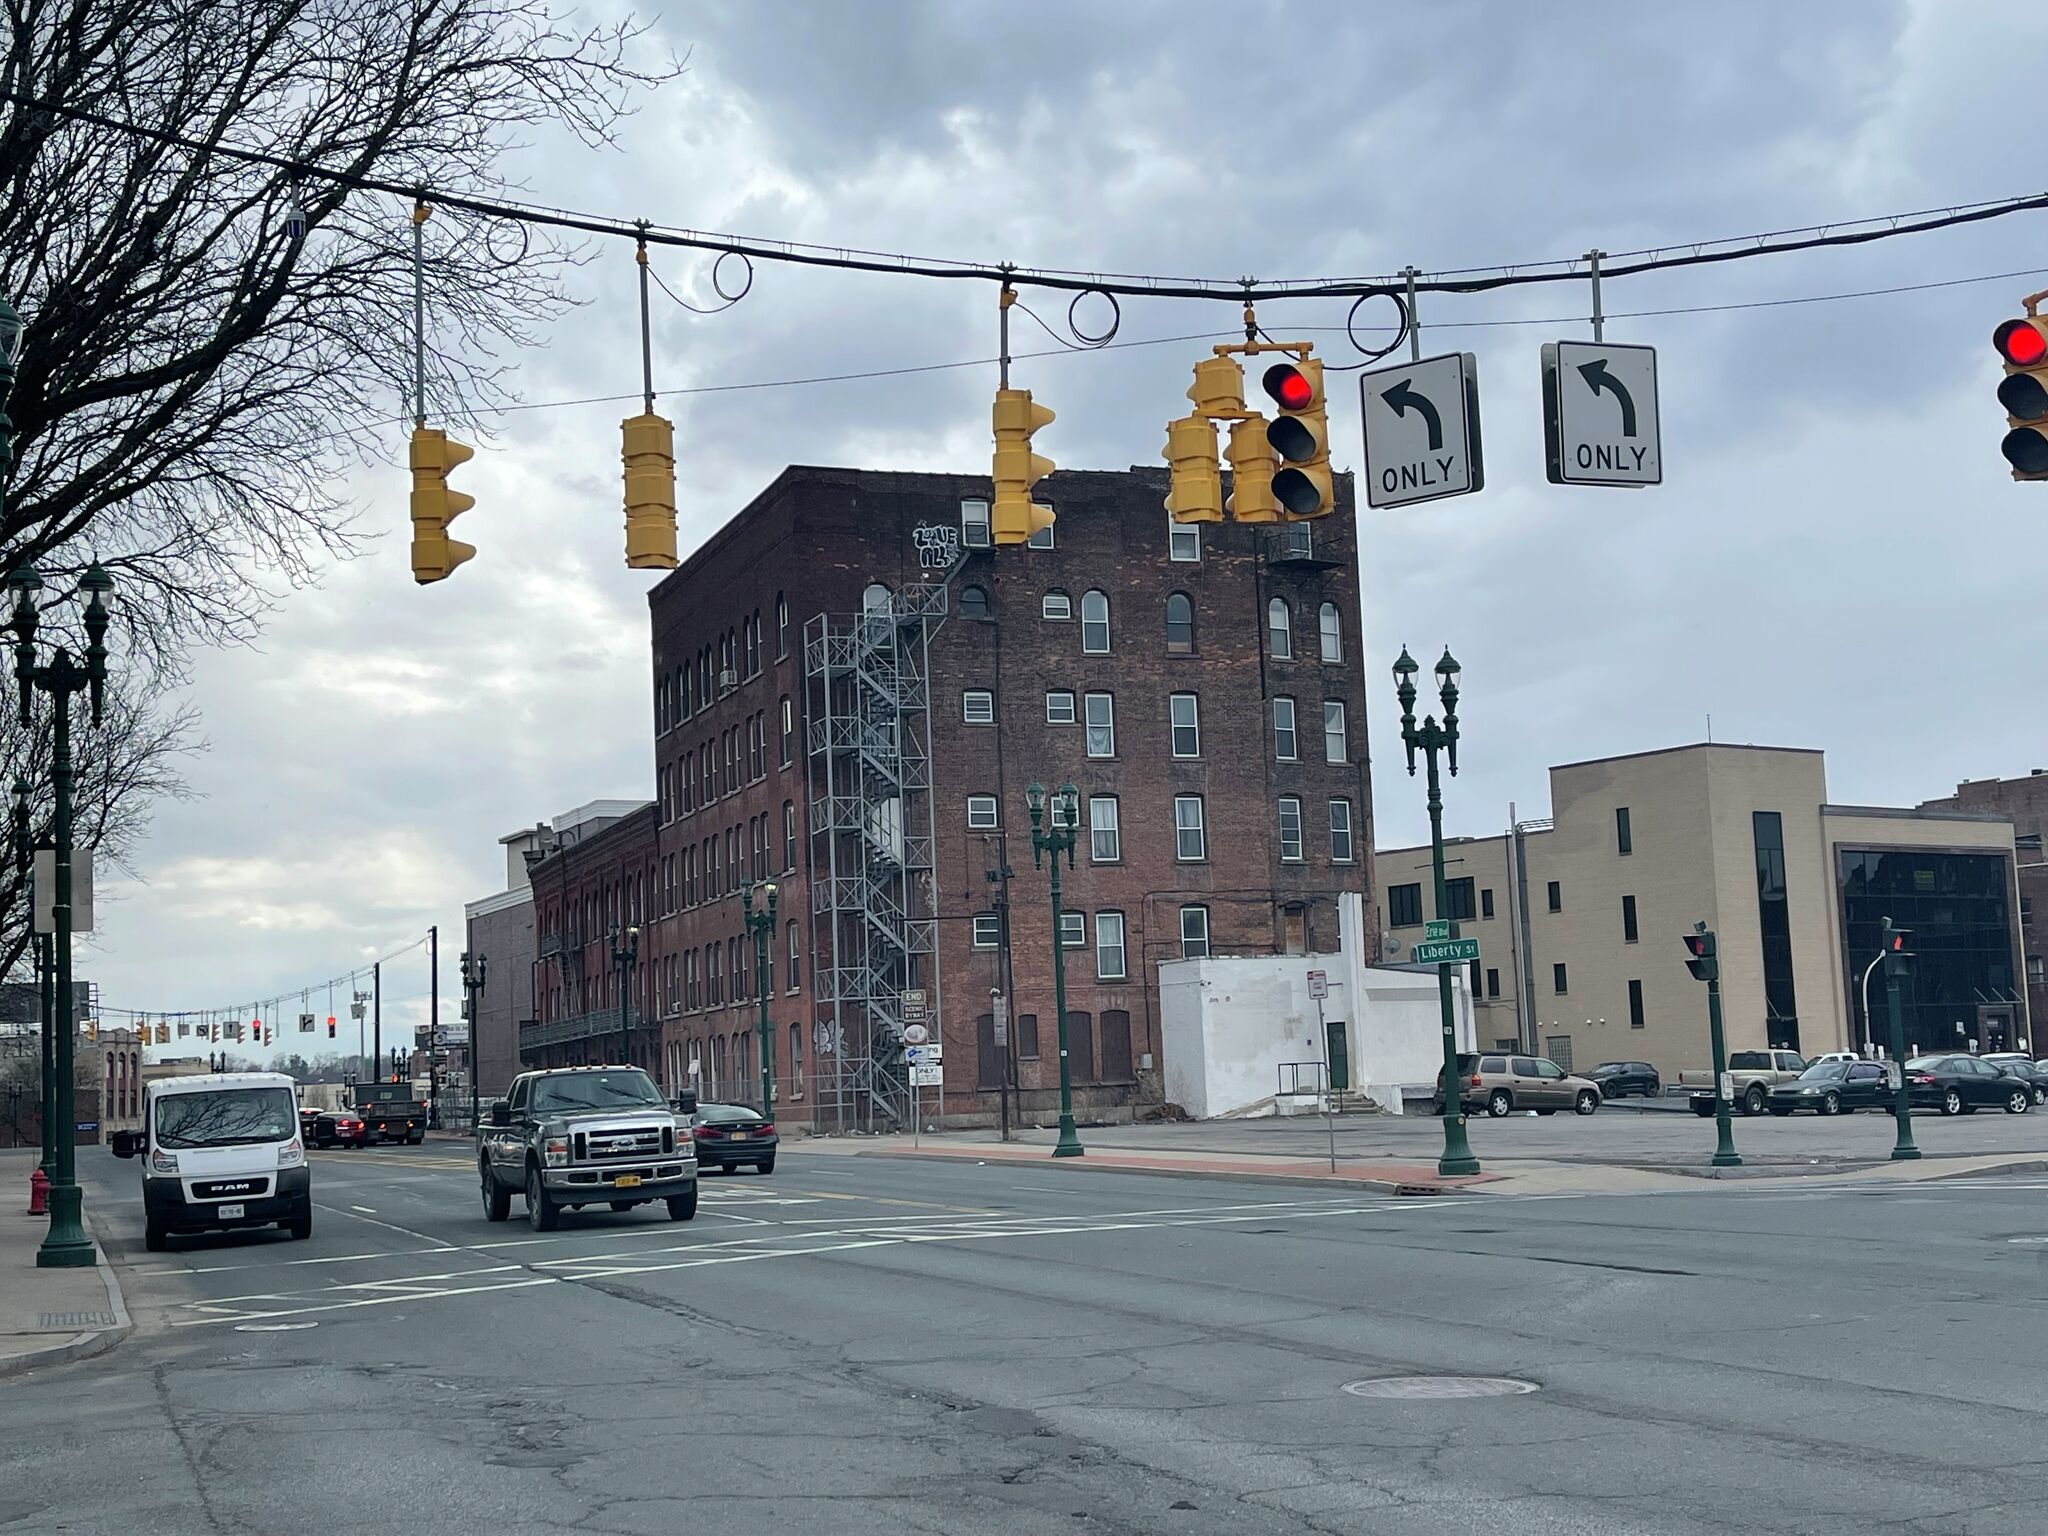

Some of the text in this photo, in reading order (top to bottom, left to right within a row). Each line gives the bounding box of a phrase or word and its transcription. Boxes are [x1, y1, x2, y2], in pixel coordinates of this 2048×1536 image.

[1576, 443, 1647, 471] ONLY
[1382, 456, 1454, 493] ONLY
[912, 525, 958, 549] LOVE
[1421, 944, 1475, 959] Liberty St
[906, 993, 922, 1001] END
